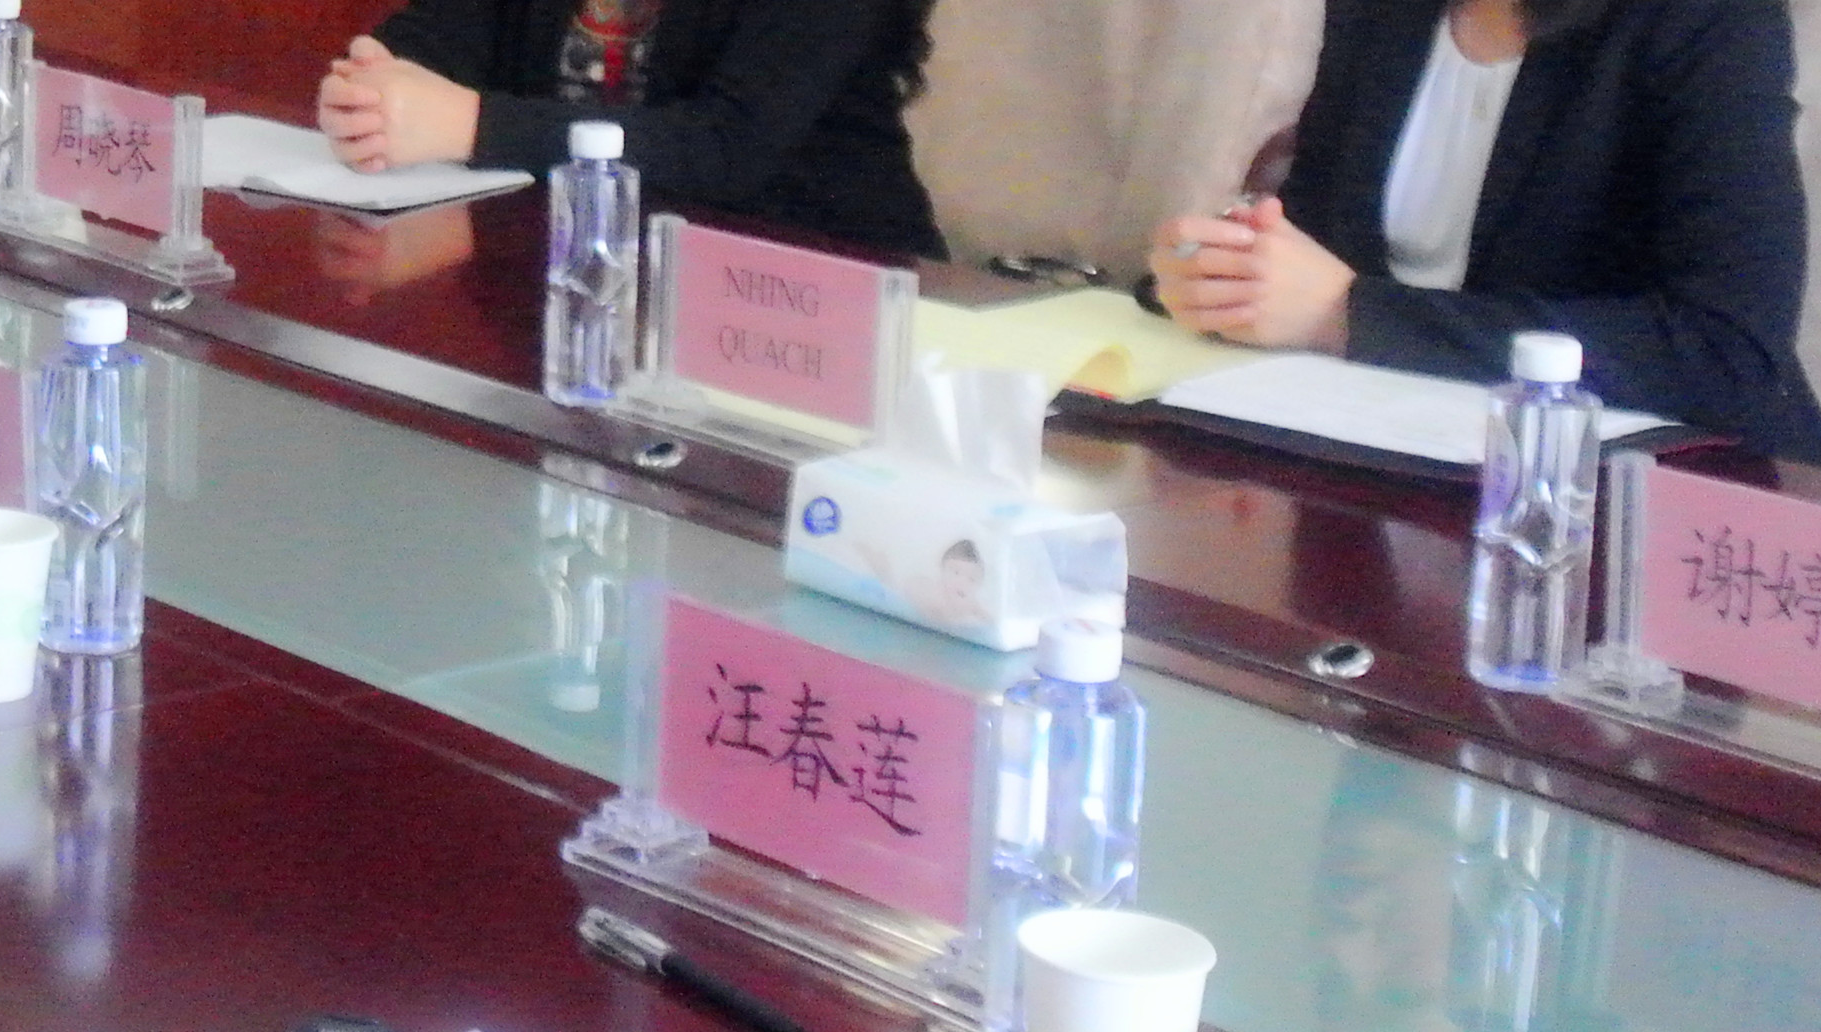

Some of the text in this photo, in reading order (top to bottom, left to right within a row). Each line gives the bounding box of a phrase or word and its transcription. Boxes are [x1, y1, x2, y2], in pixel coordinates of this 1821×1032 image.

[51, 103, 156, 184] 周晓琴
[722, 265, 822, 319] NHING
[717, 324, 825, 380] QUACH
[703, 663, 922, 838] 汪春莲
